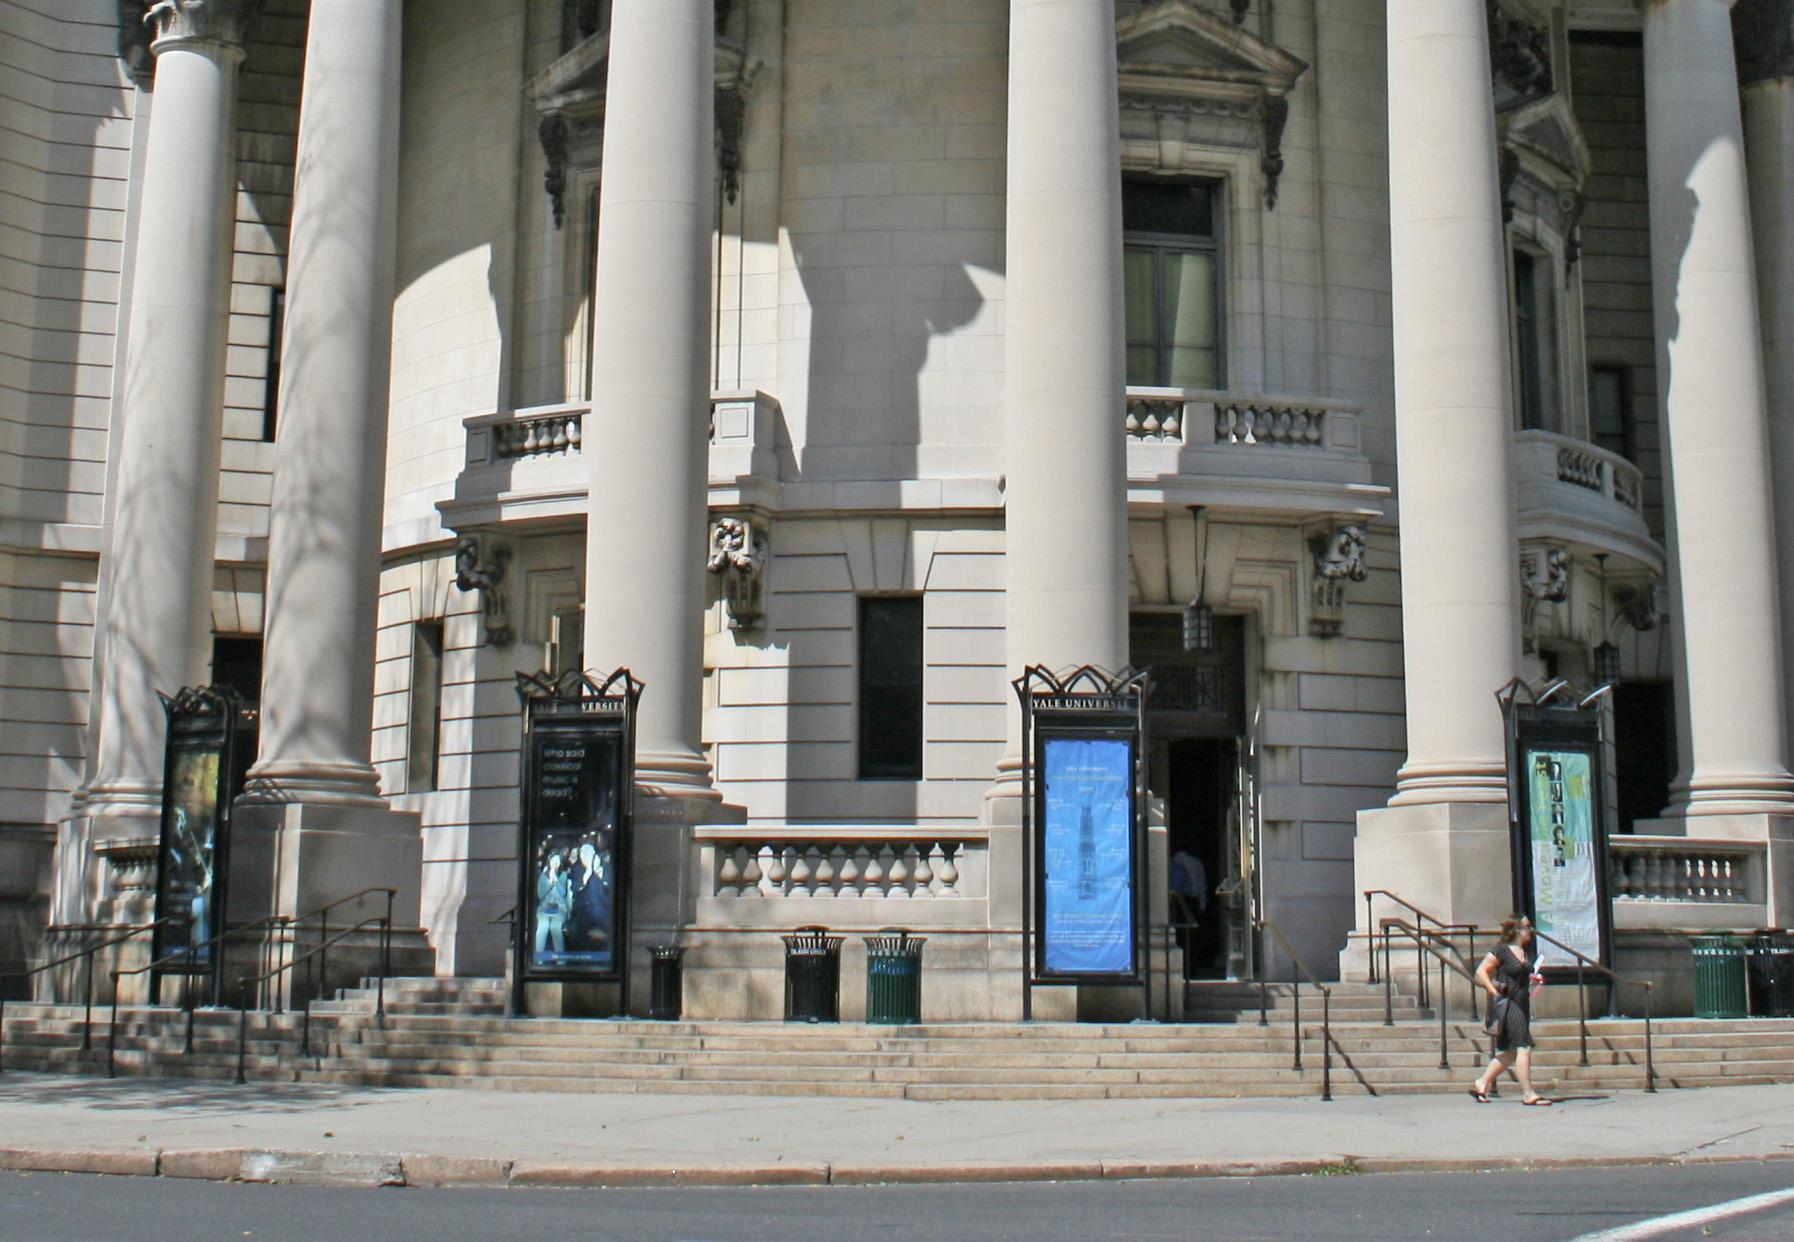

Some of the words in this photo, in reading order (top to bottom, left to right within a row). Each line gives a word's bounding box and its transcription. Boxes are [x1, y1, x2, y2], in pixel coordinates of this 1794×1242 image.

[1033, 699, 1061, 708] YALE
[1065, 699, 1133, 709] UNIVERSIT
[566, 748, 585, 757] said
